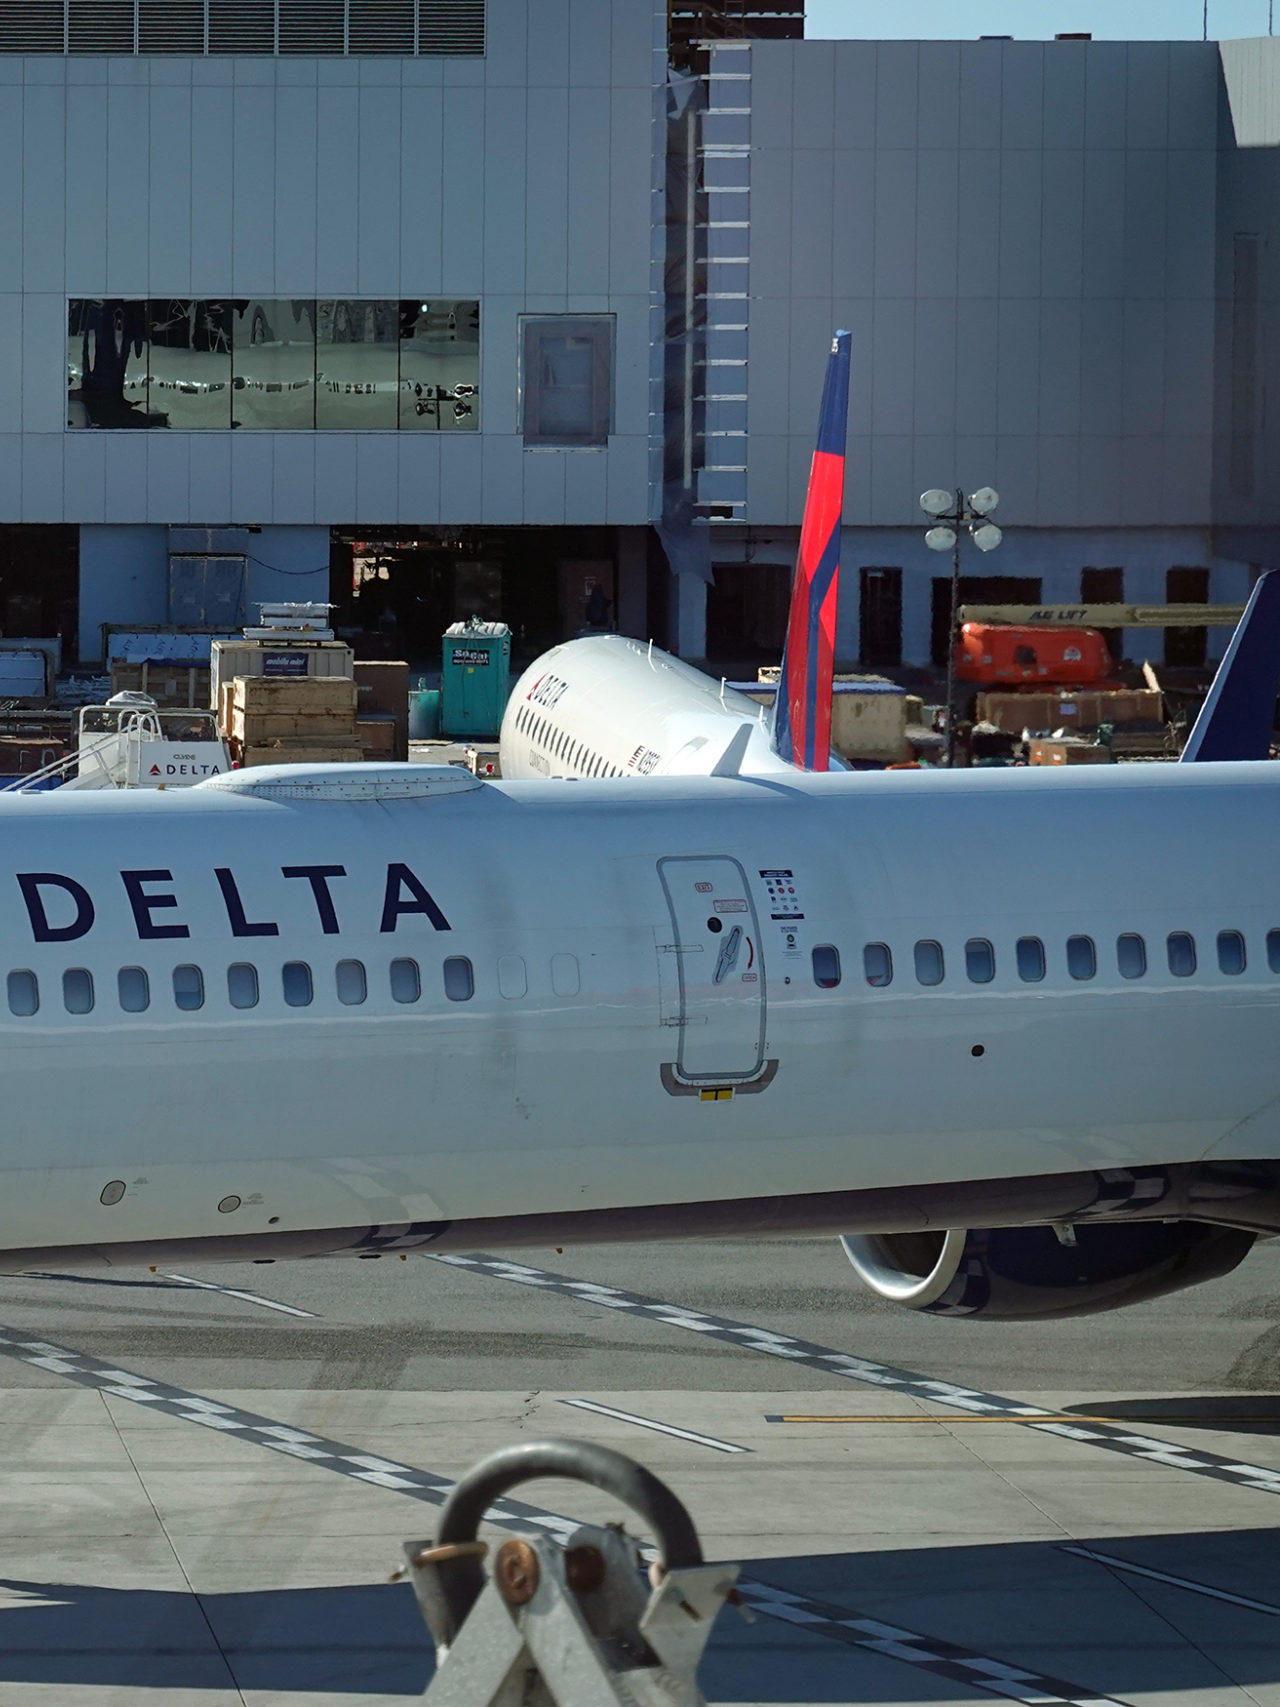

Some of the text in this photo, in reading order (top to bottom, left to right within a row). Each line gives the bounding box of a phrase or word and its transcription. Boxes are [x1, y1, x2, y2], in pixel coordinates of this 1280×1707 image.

[534, 675, 570, 711] DELTA
[166, 764, 221, 775] DELTA
[16, 862, 452, 943] DELTA
